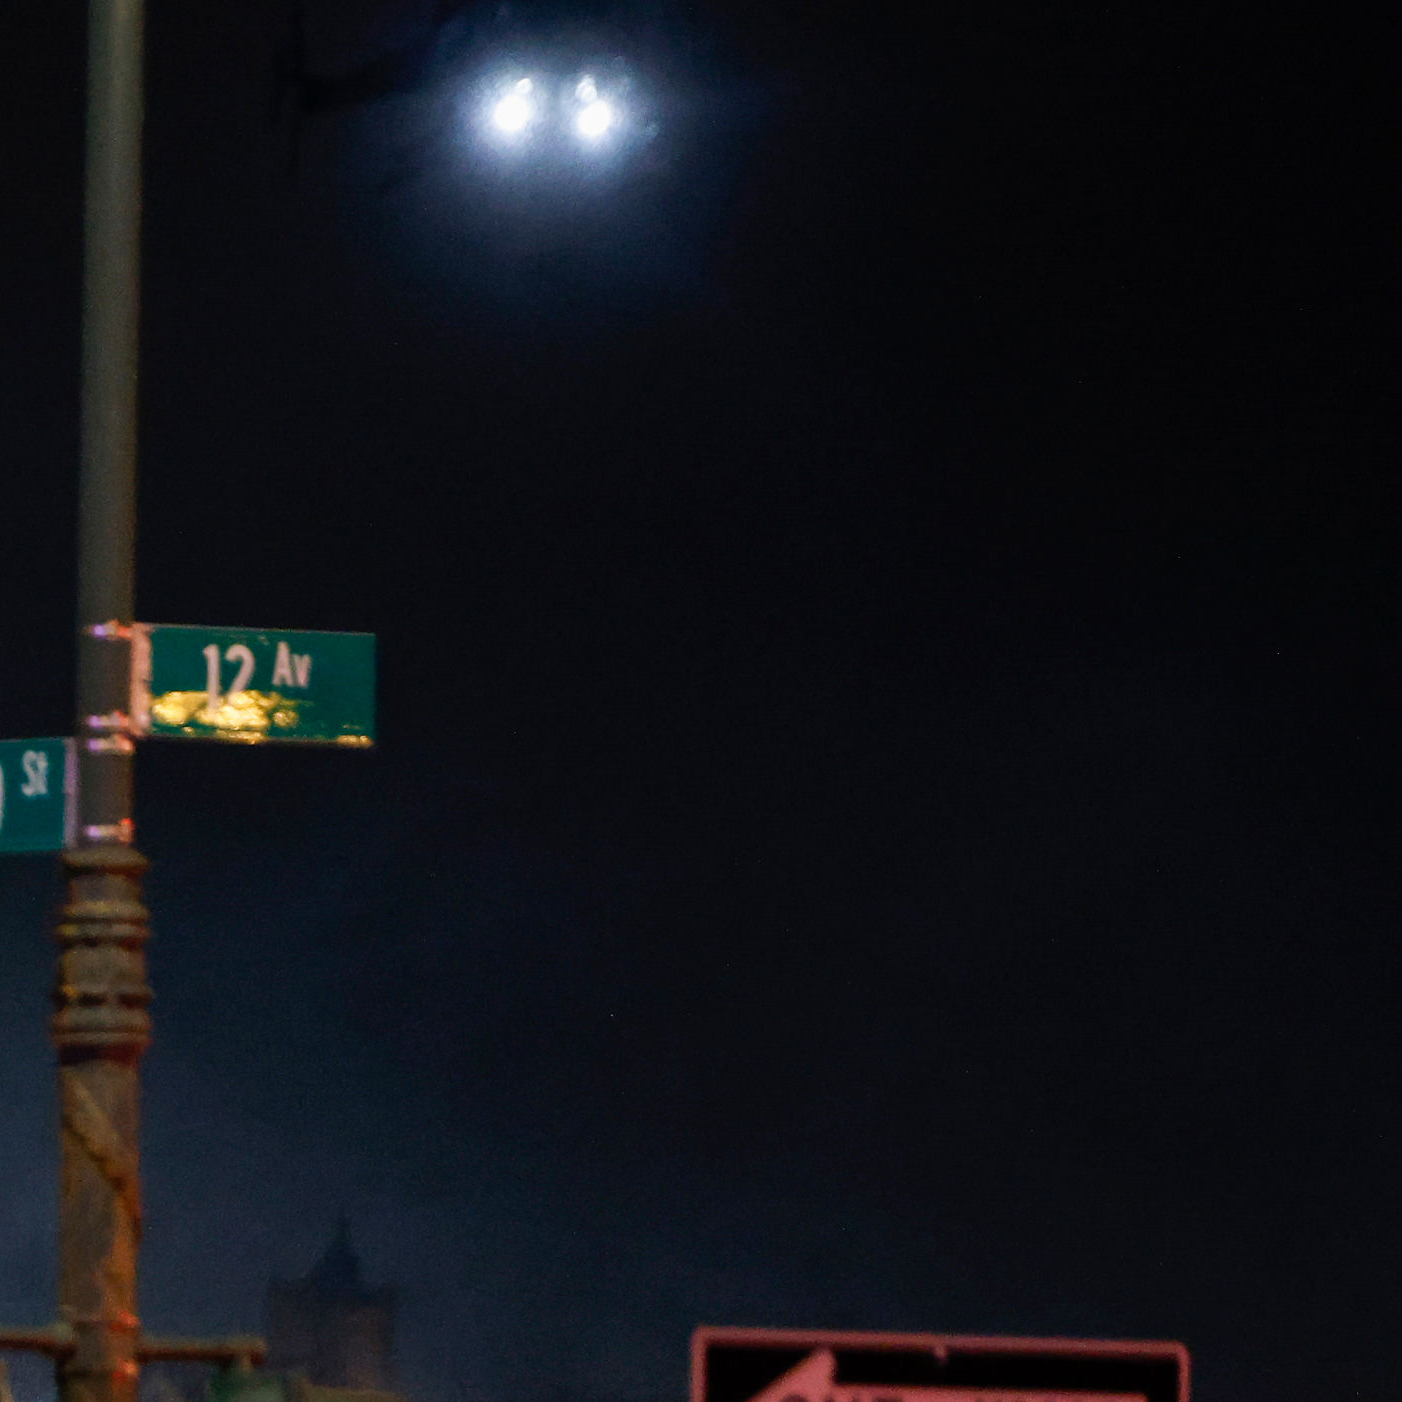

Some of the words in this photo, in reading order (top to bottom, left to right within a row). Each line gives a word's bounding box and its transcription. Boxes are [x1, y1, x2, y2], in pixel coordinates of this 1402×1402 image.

[202, 643, 257, 714] 12
[272, 641, 313, 688] Av
[21, 750, 49, 797] St
